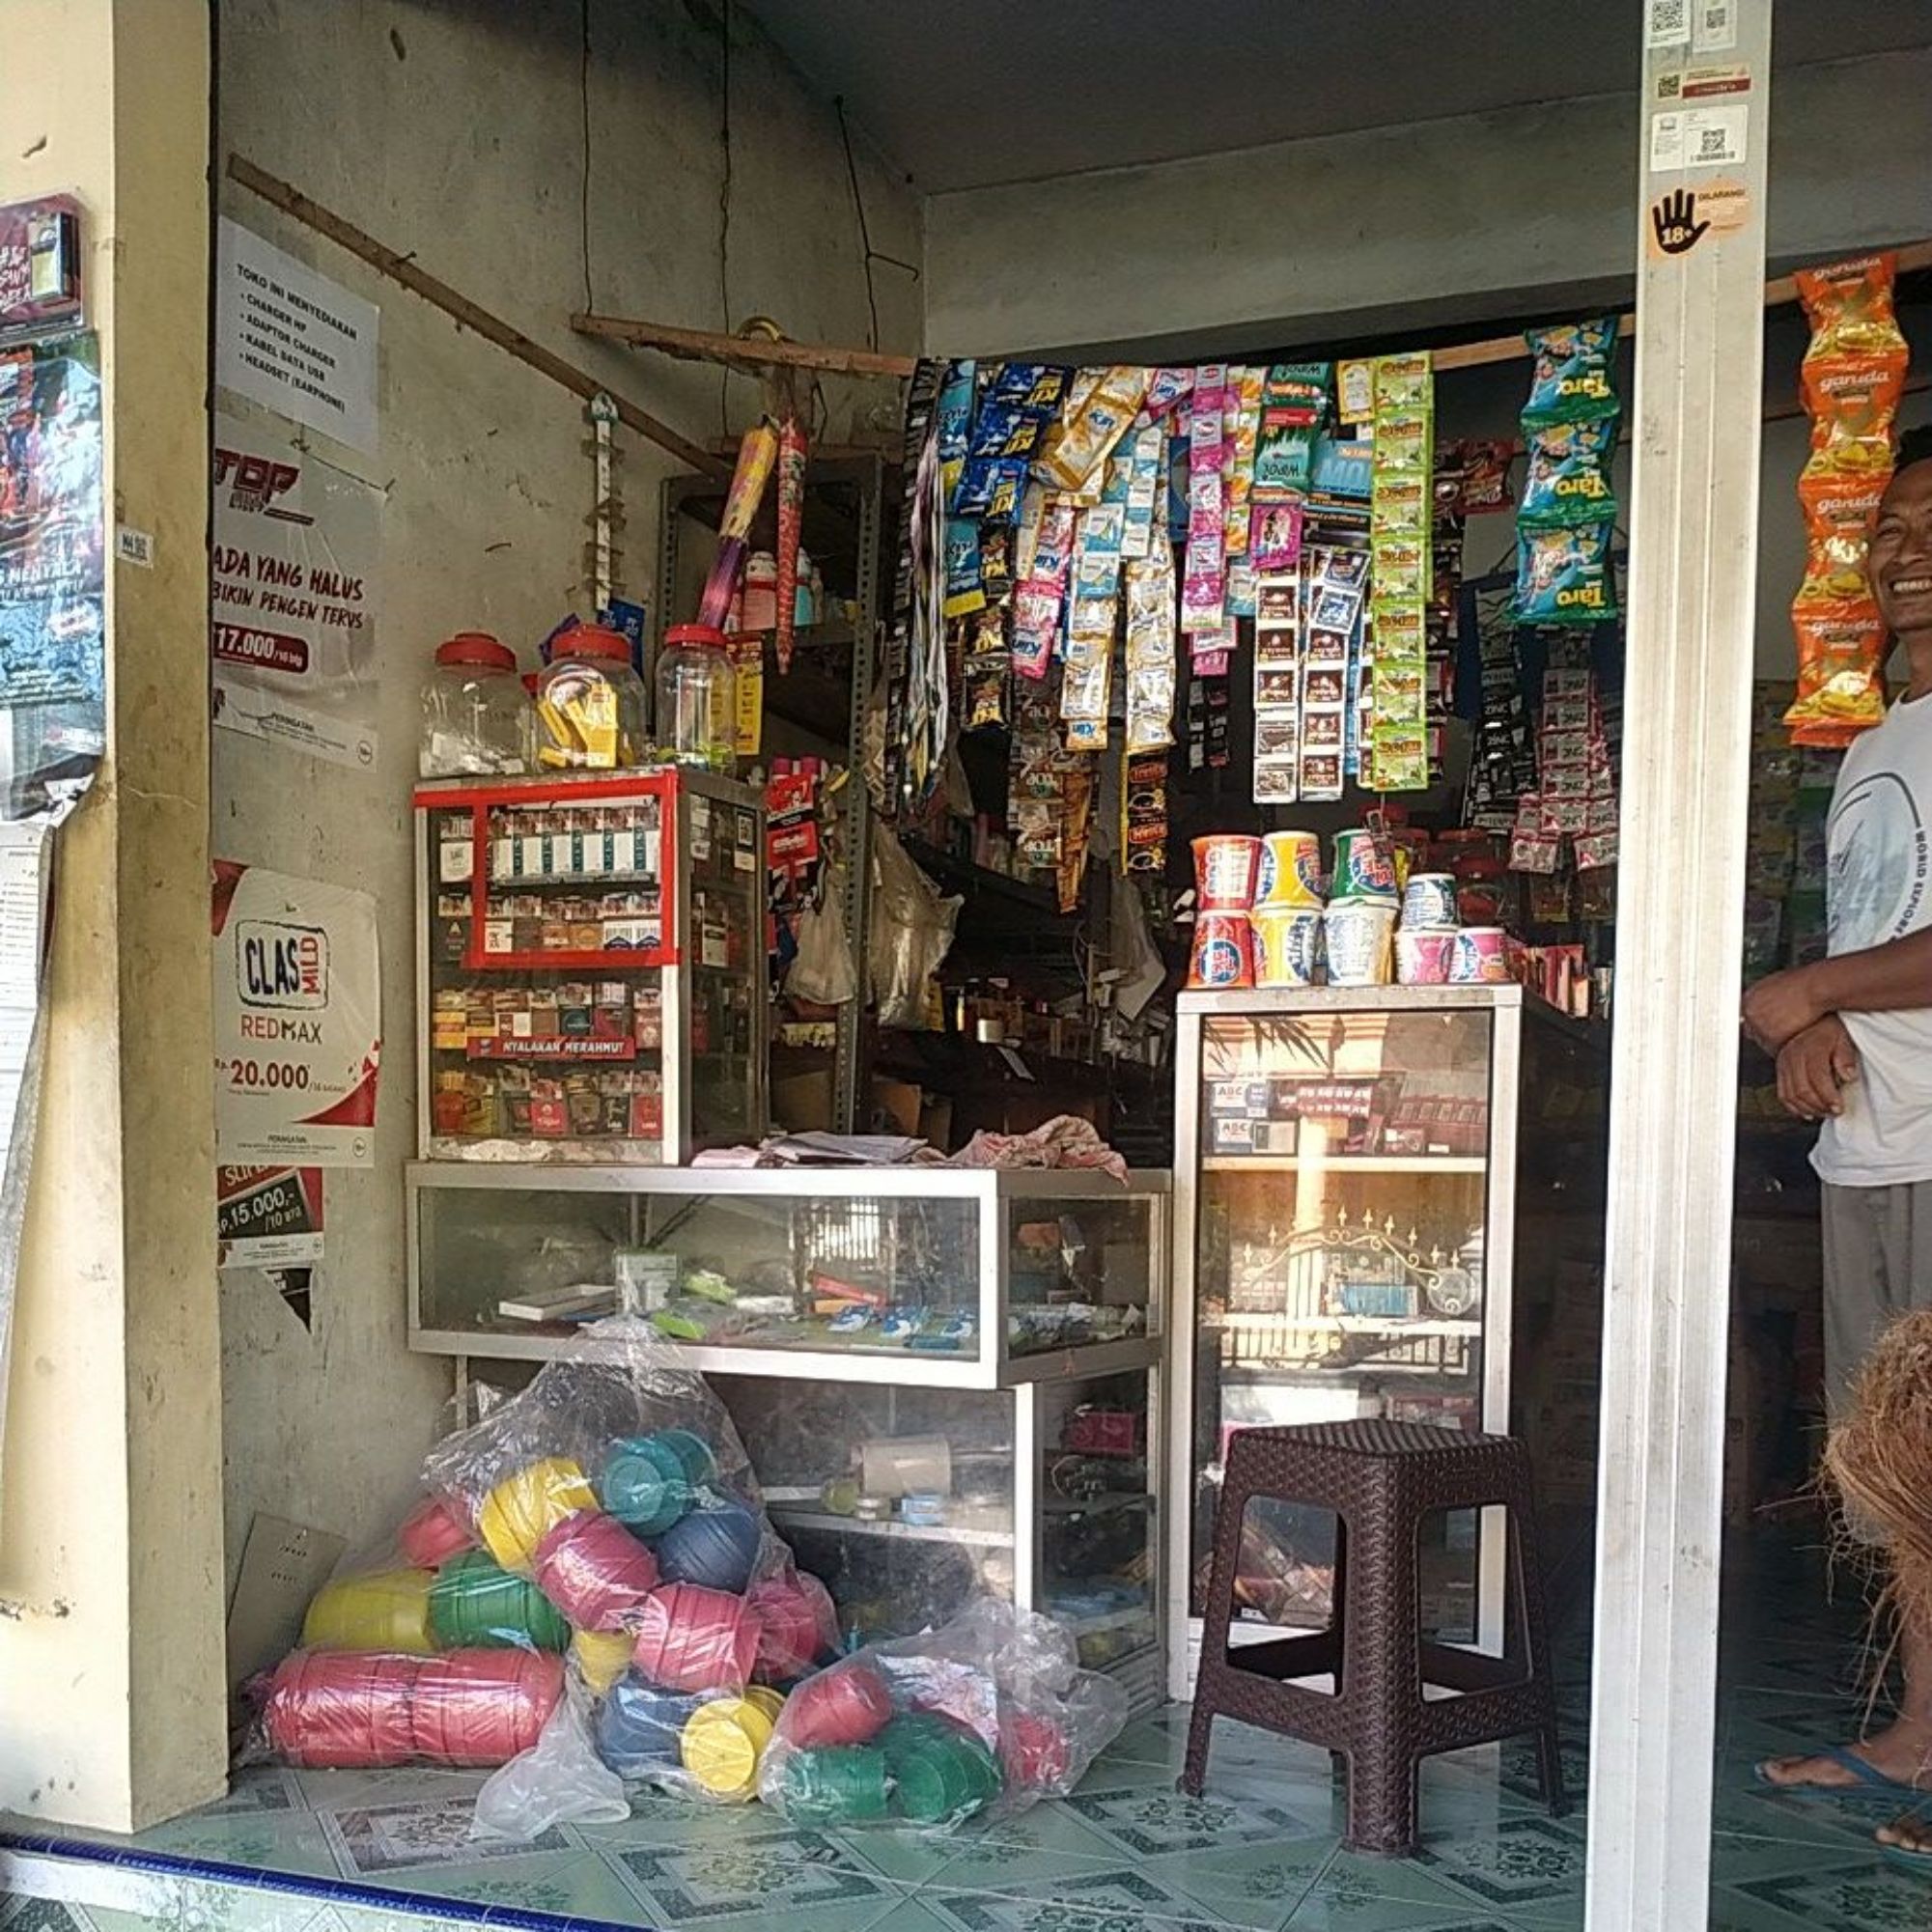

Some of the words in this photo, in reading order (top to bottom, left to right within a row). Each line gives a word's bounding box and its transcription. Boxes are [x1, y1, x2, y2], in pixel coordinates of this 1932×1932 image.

[237, 263, 268, 289] TOKO
[269, 281, 285, 298] INI
[287, 291, 357, 340] MENYEDIAKAN
[247, 293, 293, 326] CHARGER
[245, 313, 291, 344] ADAPTOR
[293, 338, 336, 370] CHARGER
[245, 333, 278, 358] KABEL
[280, 350, 305, 371] DATA
[307, 364, 325, 382] USB
[244, 352, 290, 383] HEADSET
[1820, 371, 1890, 394] garuda
[1559, 376, 1611, 398] Taro
[215, 448, 300, 504] TOP
[1554, 473, 1607, 498] Taro
[213, 545, 250, 578] ADA
[257, 554, 302, 588] YANG
[309, 568, 363, 601] HALUS
[259, 591, 319, 621] PENGEN
[322, 604, 363, 629] TERUS
[1556, 587, 1607, 608] Taro
[216, 627, 276, 659] 17.000
[1916, 830, 1928, 879] WORLD
[245, 937, 300, 995] CLAS
[299, 936, 321, 995] MILD
[240, 1014, 322, 1045] REDMAX
[502, 1040, 560, 1053] NYALAKAN
[231, 1059, 310, 1089] 20.000
[1218, 1086, 1243, 1096] ABC
[1222, 1122, 1248, 1132] ABC
